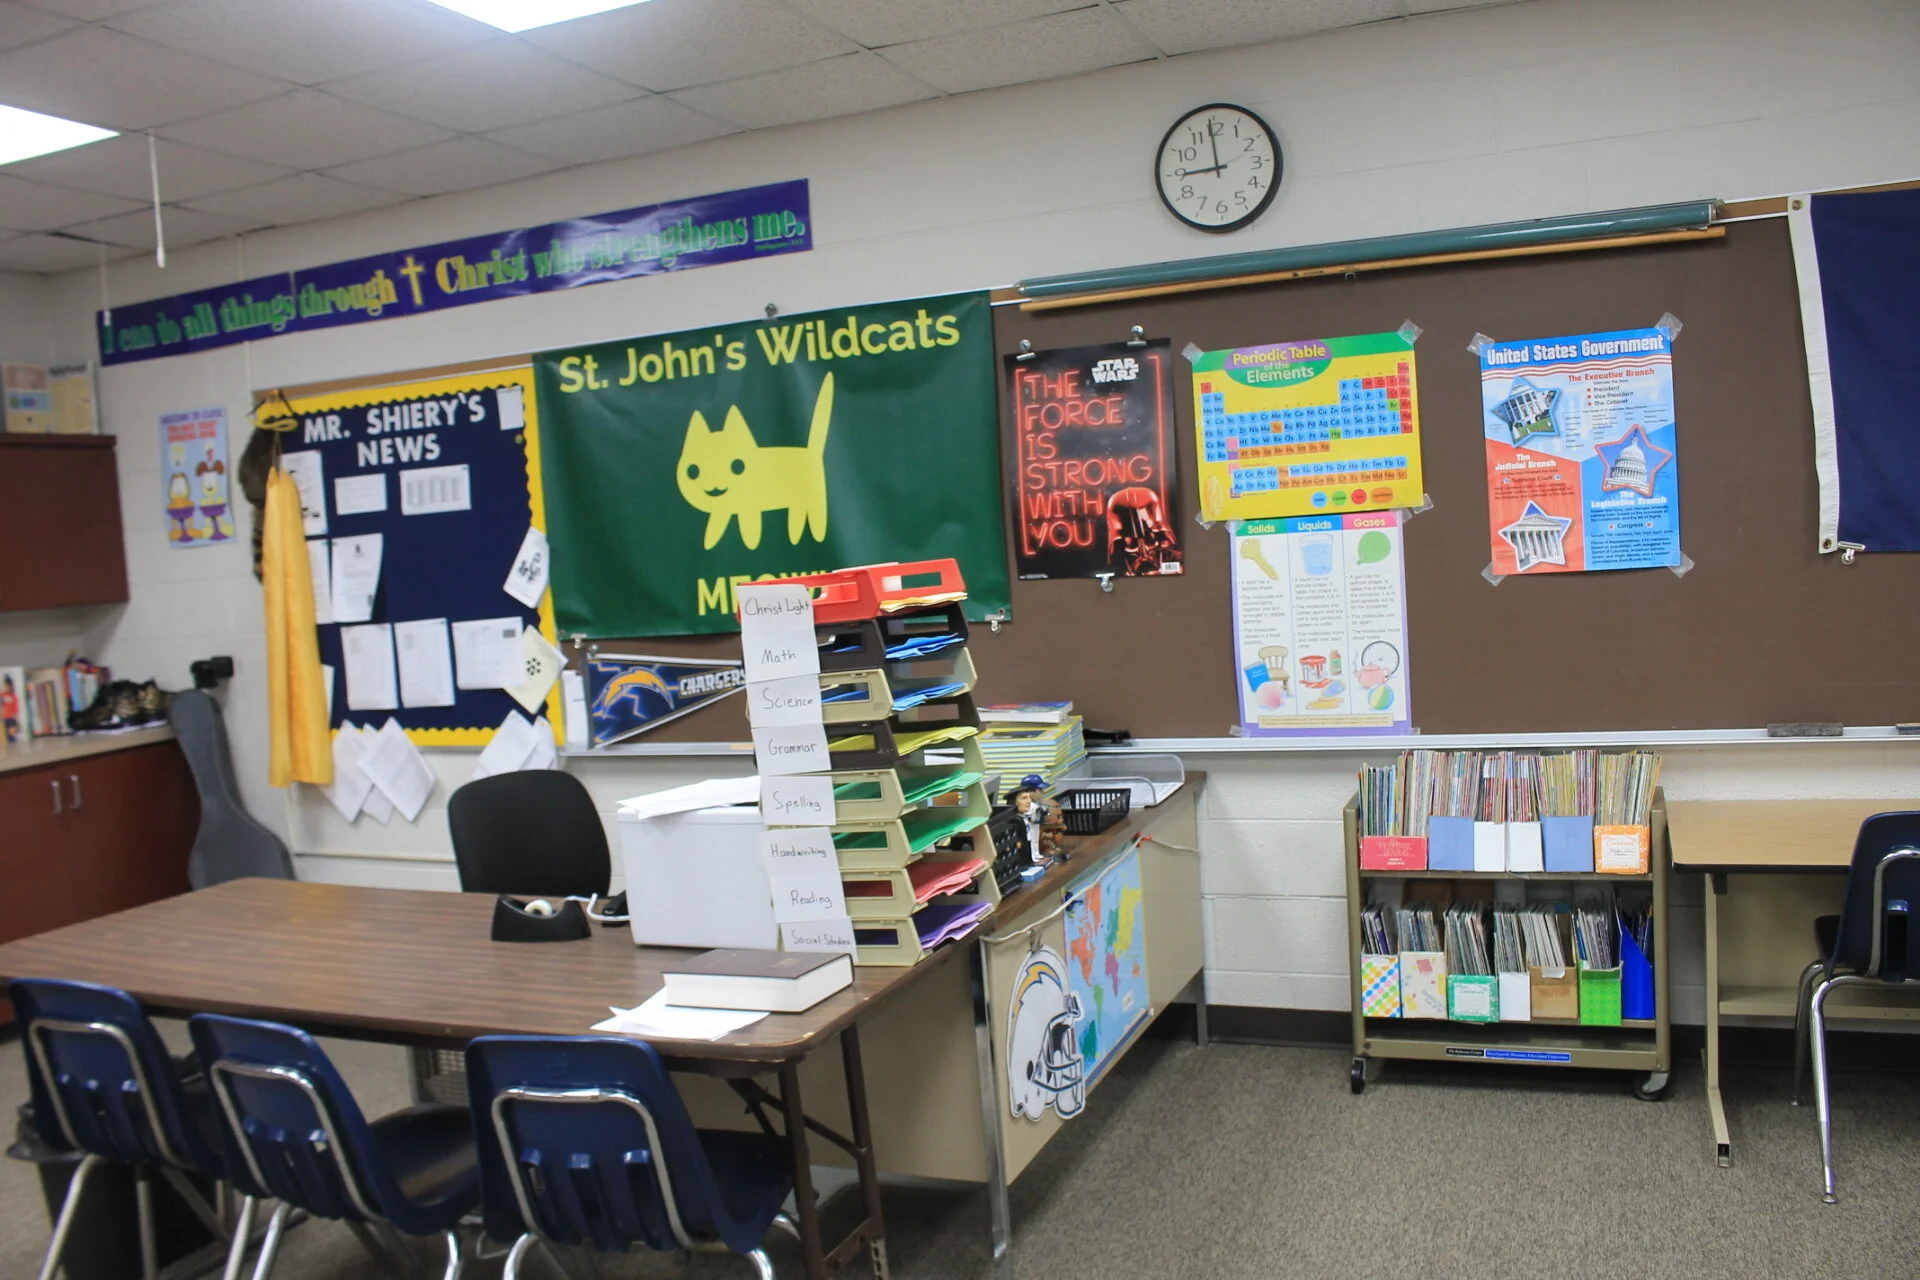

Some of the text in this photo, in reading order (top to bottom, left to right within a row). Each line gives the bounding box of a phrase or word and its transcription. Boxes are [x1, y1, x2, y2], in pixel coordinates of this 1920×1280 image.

[1192, 132, 1203, 146] 11
[1234, 124, 1238, 138] 1
[1243, 138, 1255, 152] 2
[1177, 147, 1197, 163] 10
[1250, 156, 1262, 170] 3
[1174, 168, 1187, 182] 9
[1248, 176, 1258, 188] 4
[1181, 185, 1194, 200] 8
[1234, 190, 1246, 206] 5
[1197, 196, 1208, 210] 7
[1216, 200, 1228, 214] 6
[156, 311, 182, 345] do
[181, 302, 218, 341] all
[218, 292, 298, 332] things
[297, 268, 400, 317] through
[435, 247, 530, 295] Christ
[531, 238, 585, 279] who
[590, 214, 748, 269] strengthens
[753, 207, 806, 242] me.
[557, 307, 961, 394] St. John's Wildcats
[1232, 344, 1326, 365] Periodic Table
[1487, 334, 1666, 366] United States Government
[1096, 357, 1136, 371] STAR
[1264, 361, 1290, 371] of the
[1023, 368, 1082, 399] THE
[1091, 366, 1140, 384] WARS
[1246, 366, 1315, 384] Elements
[1568, 374, 1582, 382] The
[1584, 371, 1624, 381] Executive
[1626, 368, 1656, 377] Branch
[302, 391, 486, 444] MR. SHIERY'S
[1024, 395, 1124, 432] FORCE
[356, 432, 441, 467] NEWS
[1027, 432, 1058, 461] IS
[1026, 454, 1153, 490] STRONG
[1495, 460, 1556, 471] Judicial Branch
[1027, 488, 1104, 520] WITH
[1591, 496, 1668, 508] Legislative Branch
[1029, 519, 1094, 549] YOU
[1248, 518, 1386, 534] Solids Liquids Gases
[744, 593, 810, 616] Christ Light
[760, 649, 797, 666] Math
[762, 687, 814, 710] Science
[768, 739, 818, 756] Grammar
[773, 790, 822, 813] Spelling
[770, 844, 828, 860] Handwriting
[790, 890, 832, 910] Reading
[790, 930, 822, 946] Social
